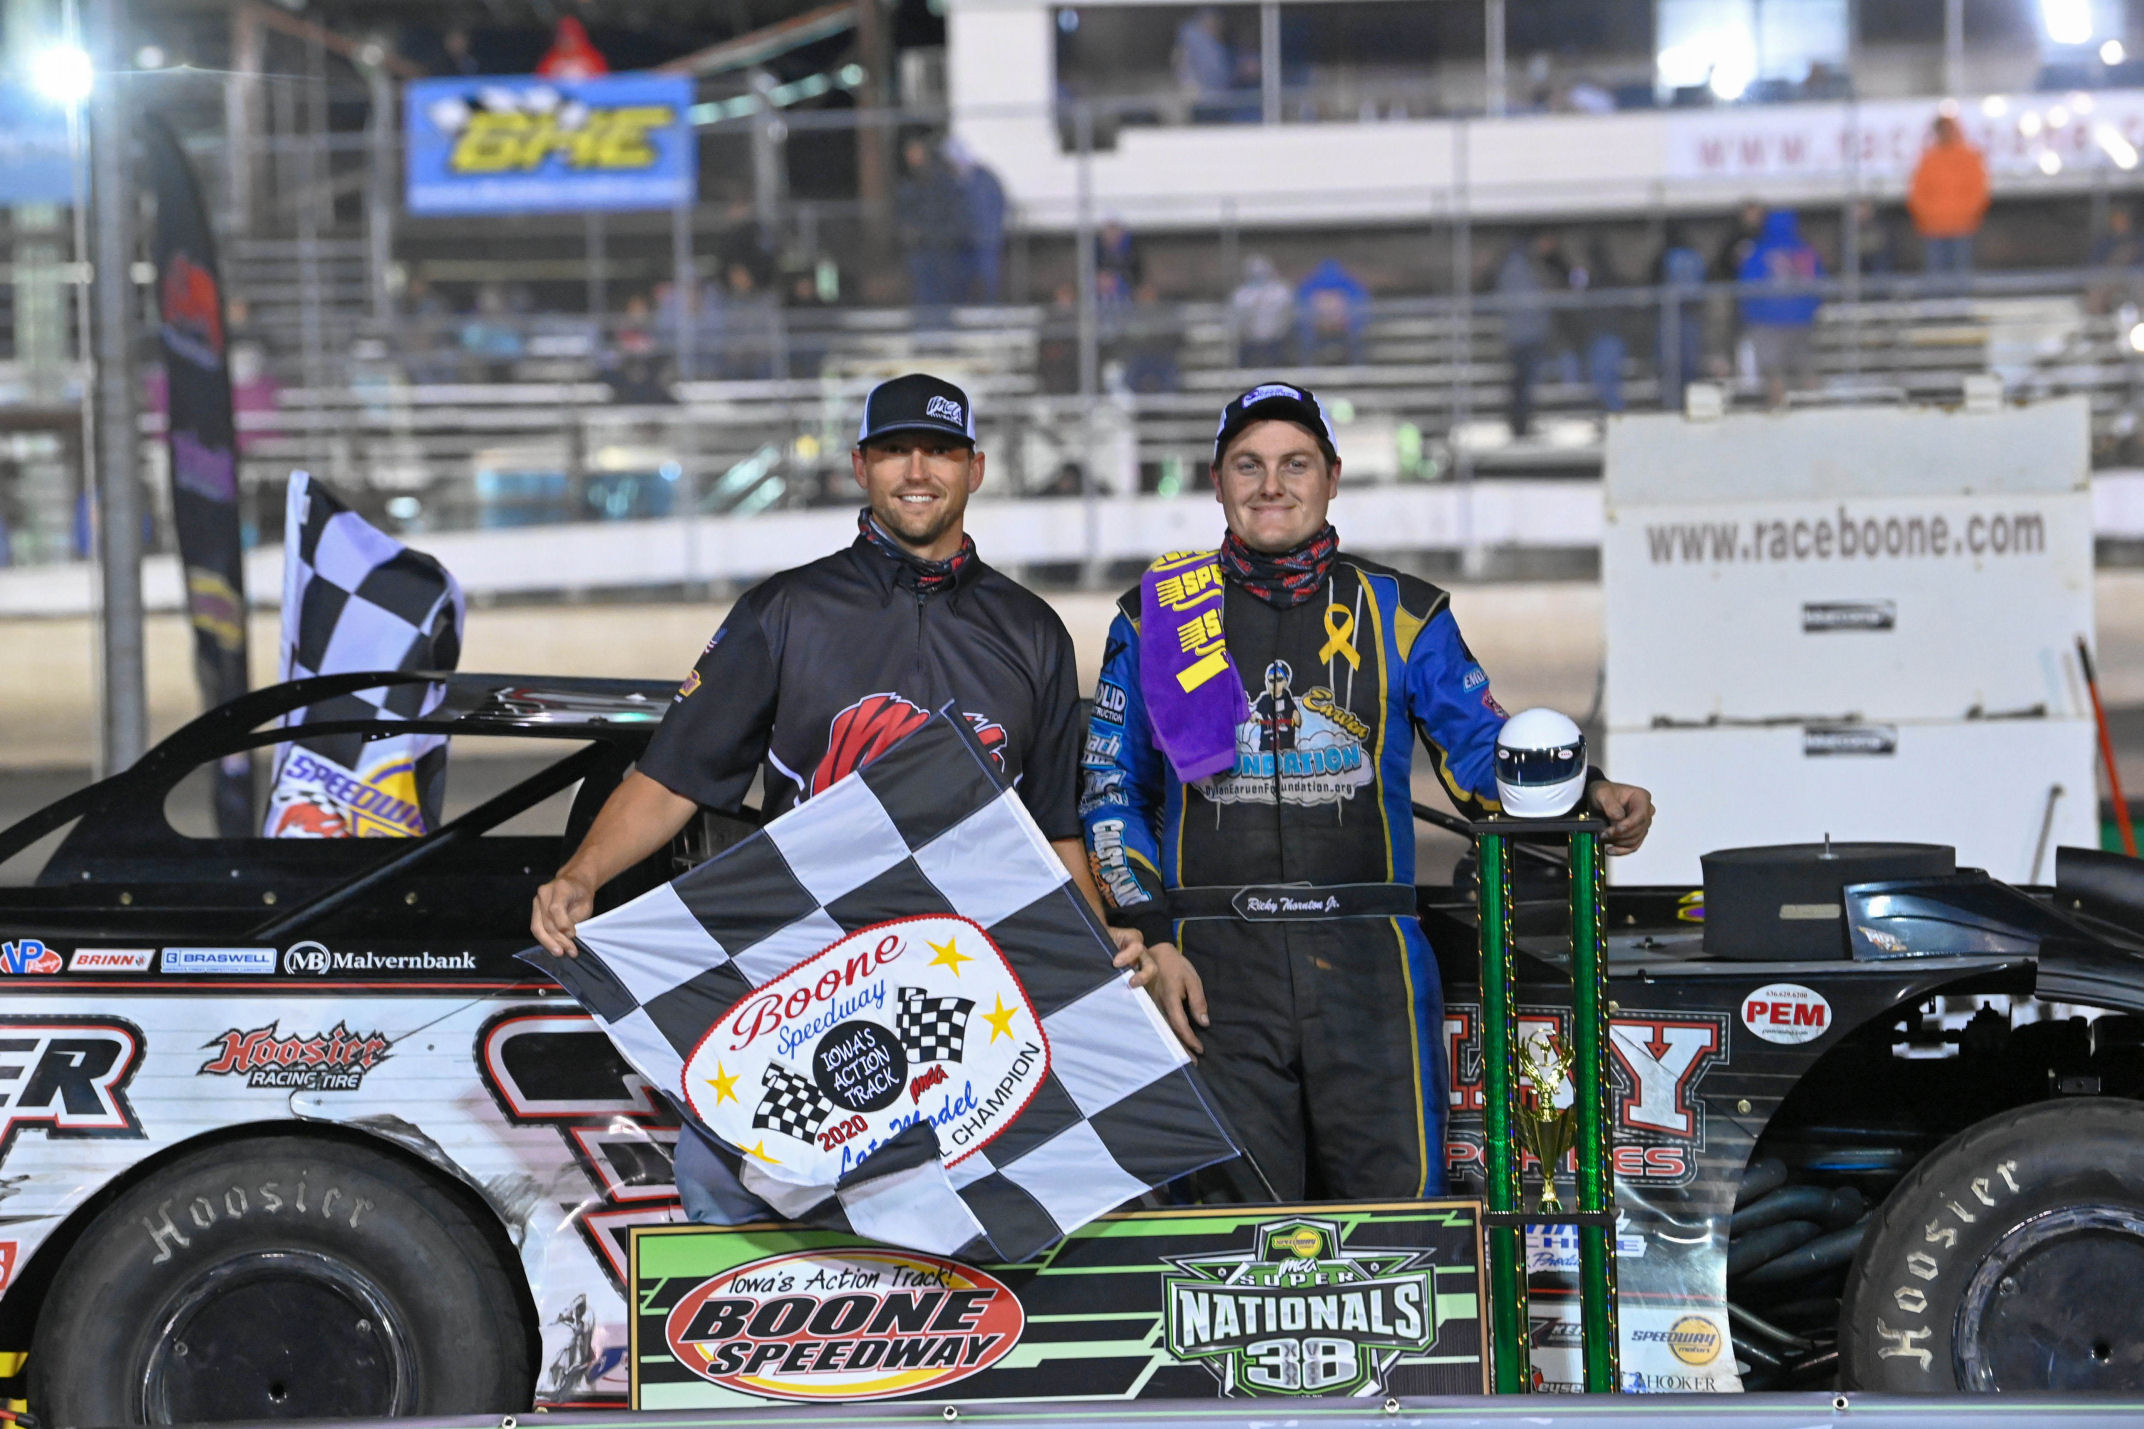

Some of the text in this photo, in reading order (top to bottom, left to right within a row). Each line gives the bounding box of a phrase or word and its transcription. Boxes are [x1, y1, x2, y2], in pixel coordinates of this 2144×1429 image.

[1646, 506, 2045, 563] www.raceboone.com
[1247, 897, 1278, 914] Ricky
[1280, 897, 1324, 911] Thornton
[3, 939, 45, 973] VP
[76, 954, 135, 966] BRINN
[183, 953, 270, 964] BRASWELL
[292, 951, 477, 971] MB Malvernbank
[729, 933, 908, 1052] Boone
[777, 979, 886, 1060] Speedway
[1746, 1001, 1826, 1027] PEM
[199, 1020, 393, 1075] Hoosier
[821, 1028, 876, 1072] IOWA'S
[250, 1071, 360, 1088] RACING TIRE
[833, 1046, 891, 1092] ACTION
[845, 1069, 900, 1107] TRACK
[951, 1041, 1041, 1146] CHAMPION
[818, 1115, 868, 1151] 2020
[140, 1170, 378, 1265] Hoosier
[729, 1263, 955, 1294] Iowa's Action Track!
[1238, 1271, 1354, 1287] SUPER
[1877, 1160, 2020, 1374] Hoosier
[678, 1287, 1001, 1344] BOONE
[1178, 1281, 1424, 1347] NATIONALS
[705, 1332, 1006, 1378] SPEEDWAY
[1631, 1329, 1717, 1347] SPEEDWAY
[1245, 1336, 1358, 1391] 38
[1647, 1375, 1718, 1392] HOOKER
